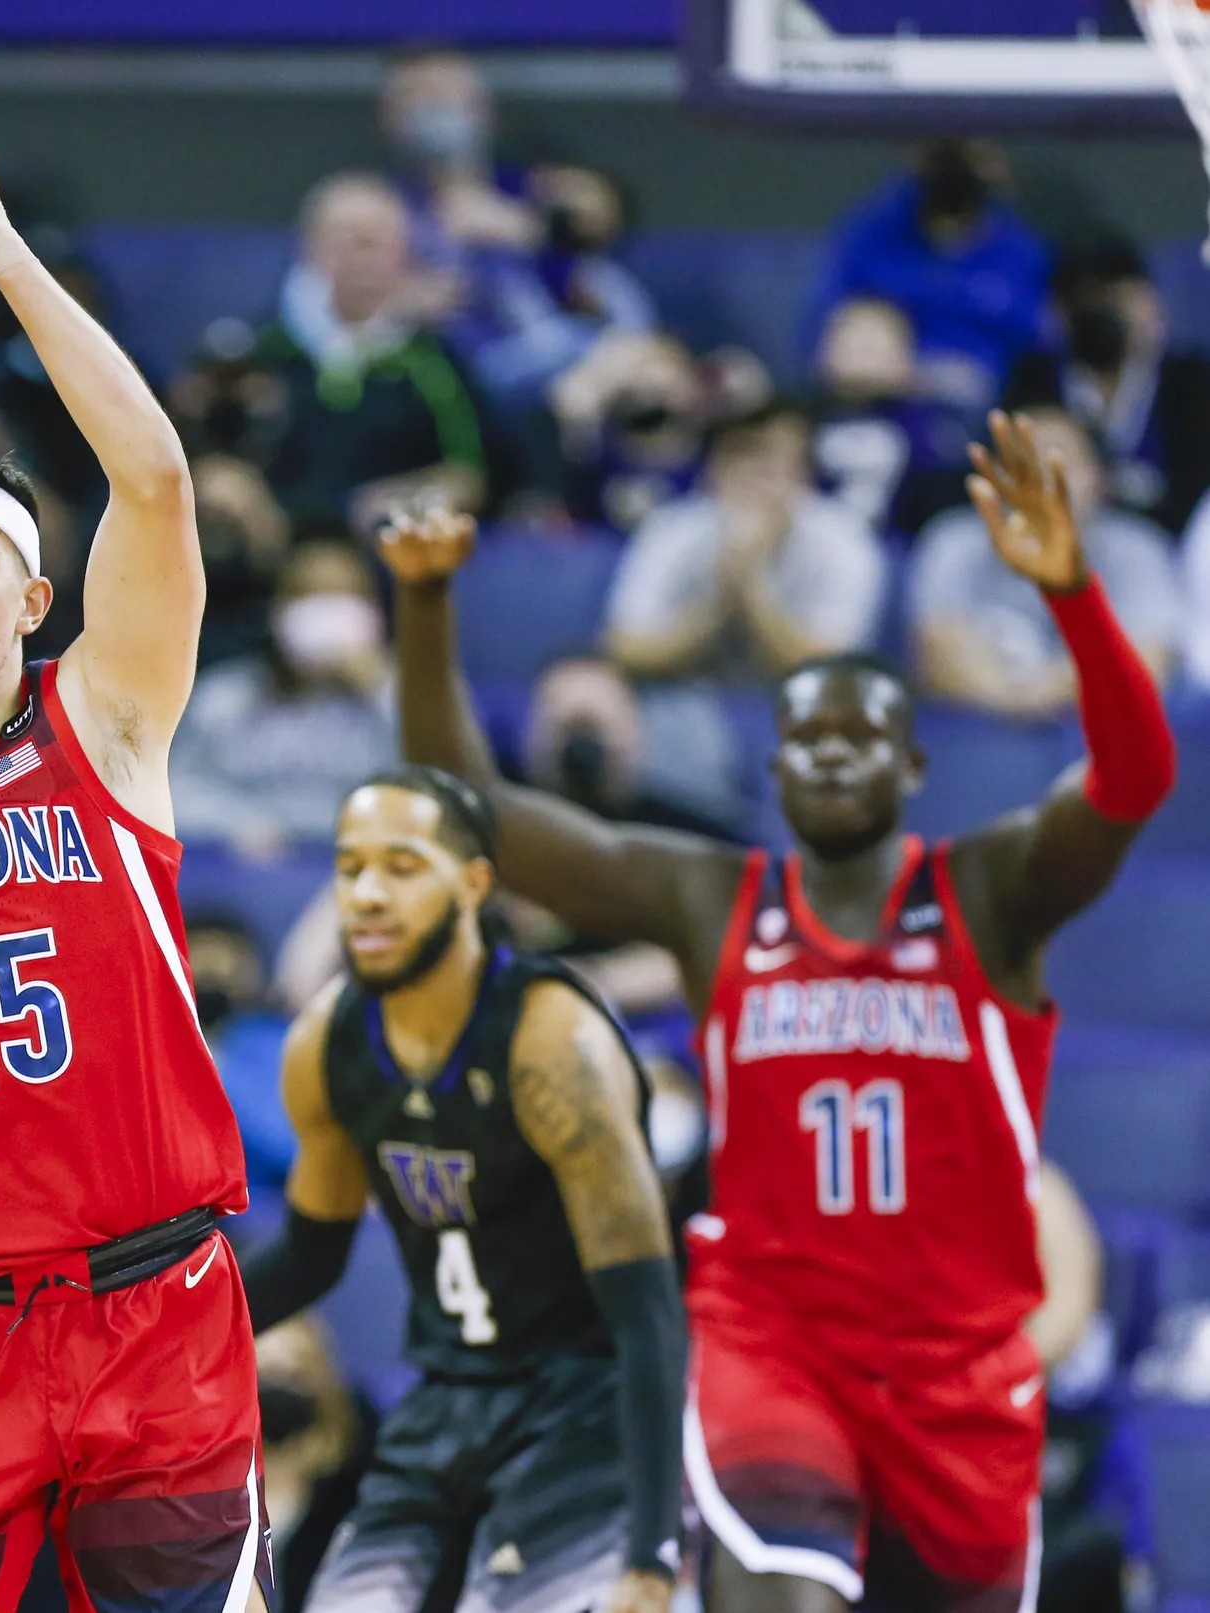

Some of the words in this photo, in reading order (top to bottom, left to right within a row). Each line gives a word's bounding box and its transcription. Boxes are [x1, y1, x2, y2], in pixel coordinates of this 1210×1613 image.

[734, 977, 970, 1063] ARIZONA
[377, 1141, 478, 1228] W
[798, 1078, 907, 1215] 11
[435, 1227, 498, 1344] 4
